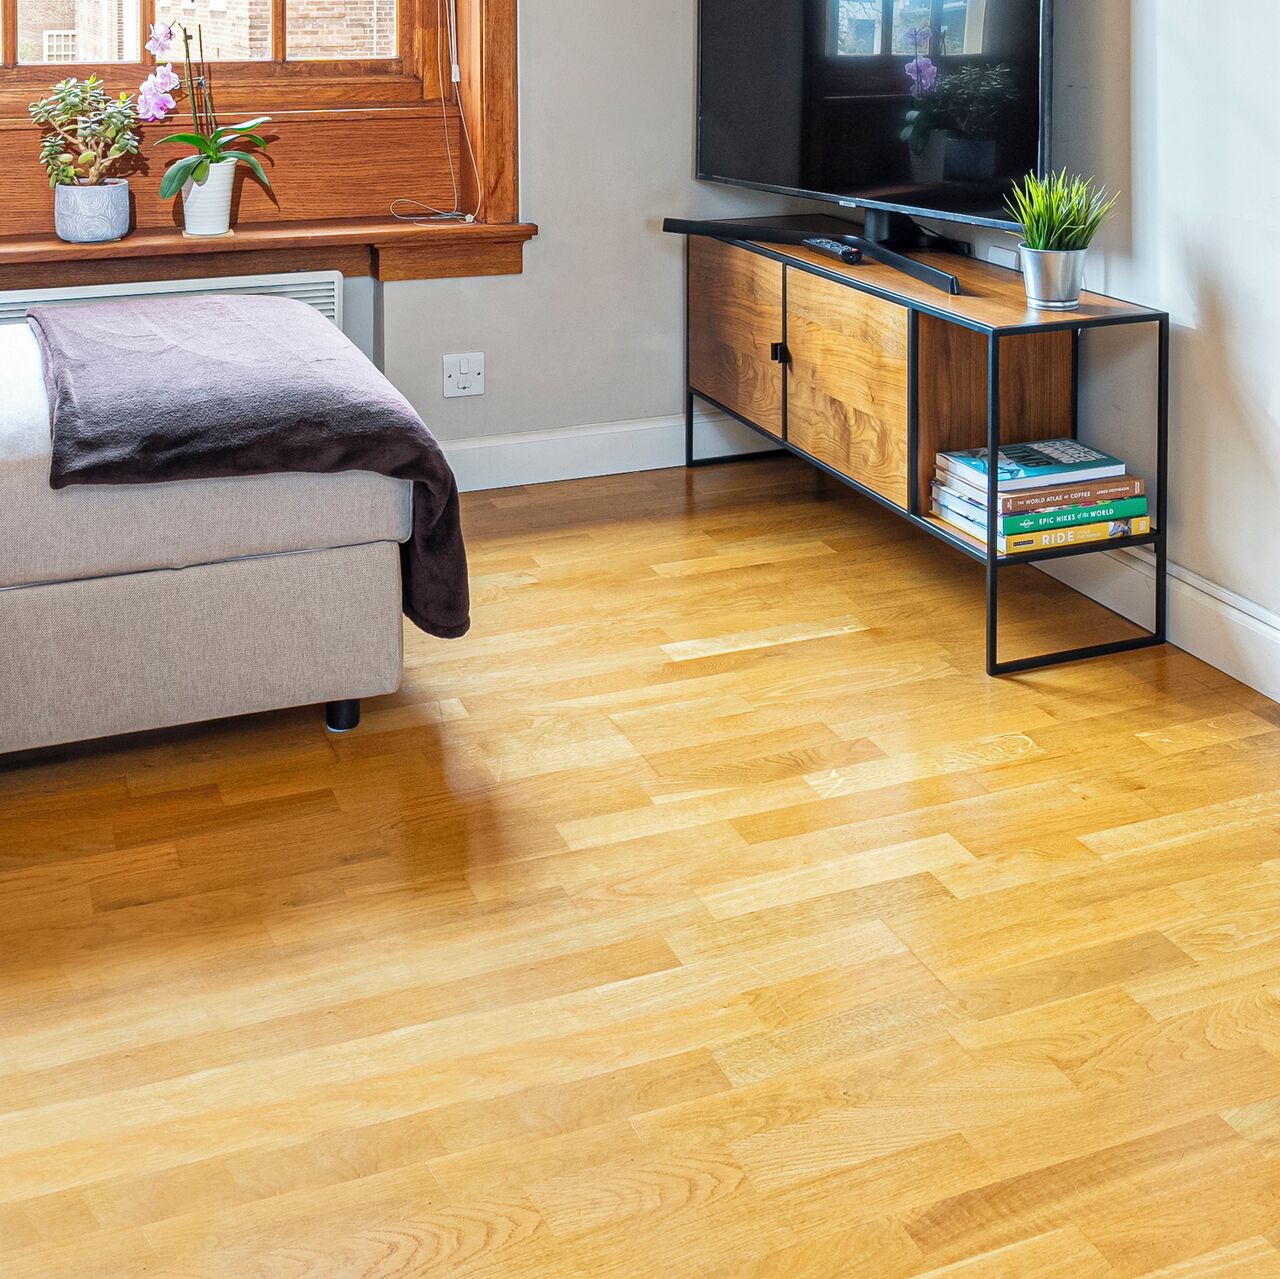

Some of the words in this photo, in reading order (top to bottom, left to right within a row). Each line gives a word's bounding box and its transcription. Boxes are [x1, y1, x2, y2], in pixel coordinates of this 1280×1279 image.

[1025, 497, 1045, 506] WORLD
[1046, 495, 1063, 504] ATLAS
[1069, 491, 1091, 501] COFFEE
[1038, 517, 1054, 525] EPIC
[1056, 514, 1076, 524] HIKES
[1090, 508, 1114, 518] WORLD
[1042, 530, 1075, 545] RIDE
